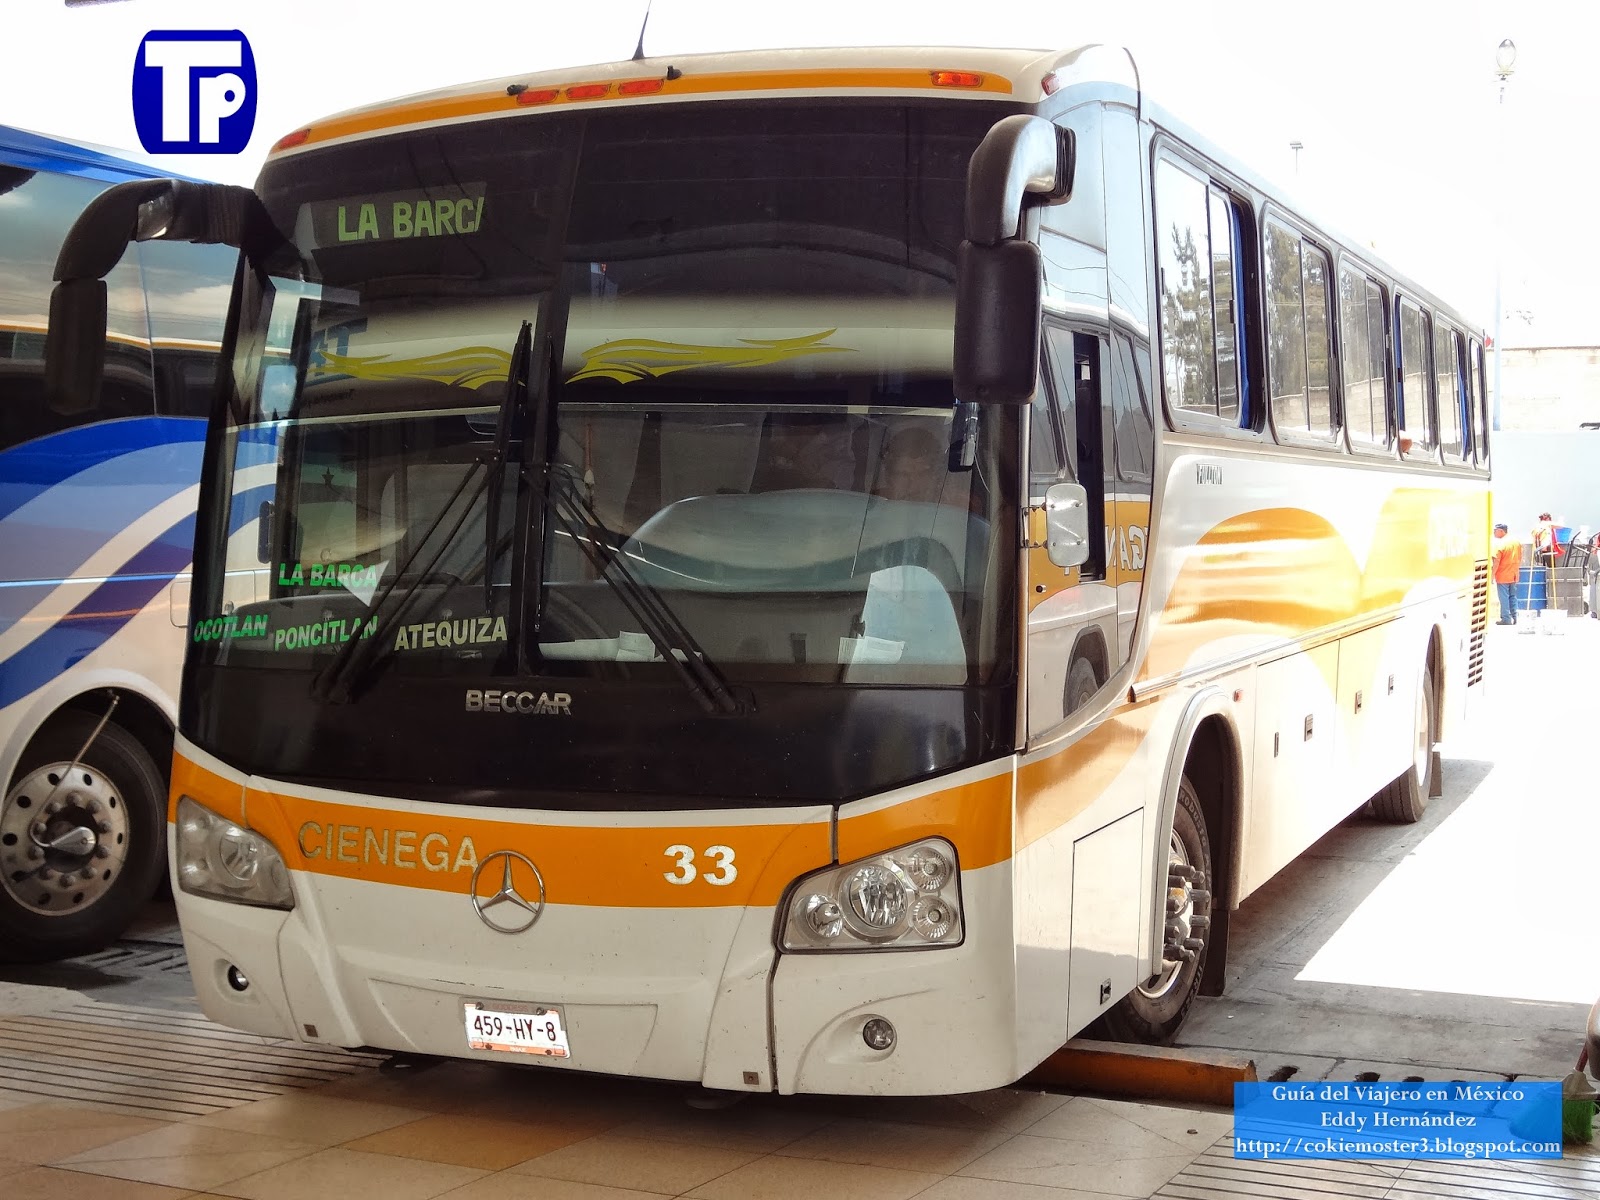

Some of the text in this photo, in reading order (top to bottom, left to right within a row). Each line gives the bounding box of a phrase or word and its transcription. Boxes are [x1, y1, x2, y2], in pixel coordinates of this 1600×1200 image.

[338, 203, 379, 242] LA
[278, 563, 378, 587] LA BARCA
[194, 614, 269, 643] OCOTLAN
[394, 616, 508, 651] ATEQUIZA
[465, 689, 573, 716] BECCAR
[298, 821, 478, 873] CIENEGA
[663, 844, 738, 886] 33
[473, 1015, 556, 1042] 459-HY-8
